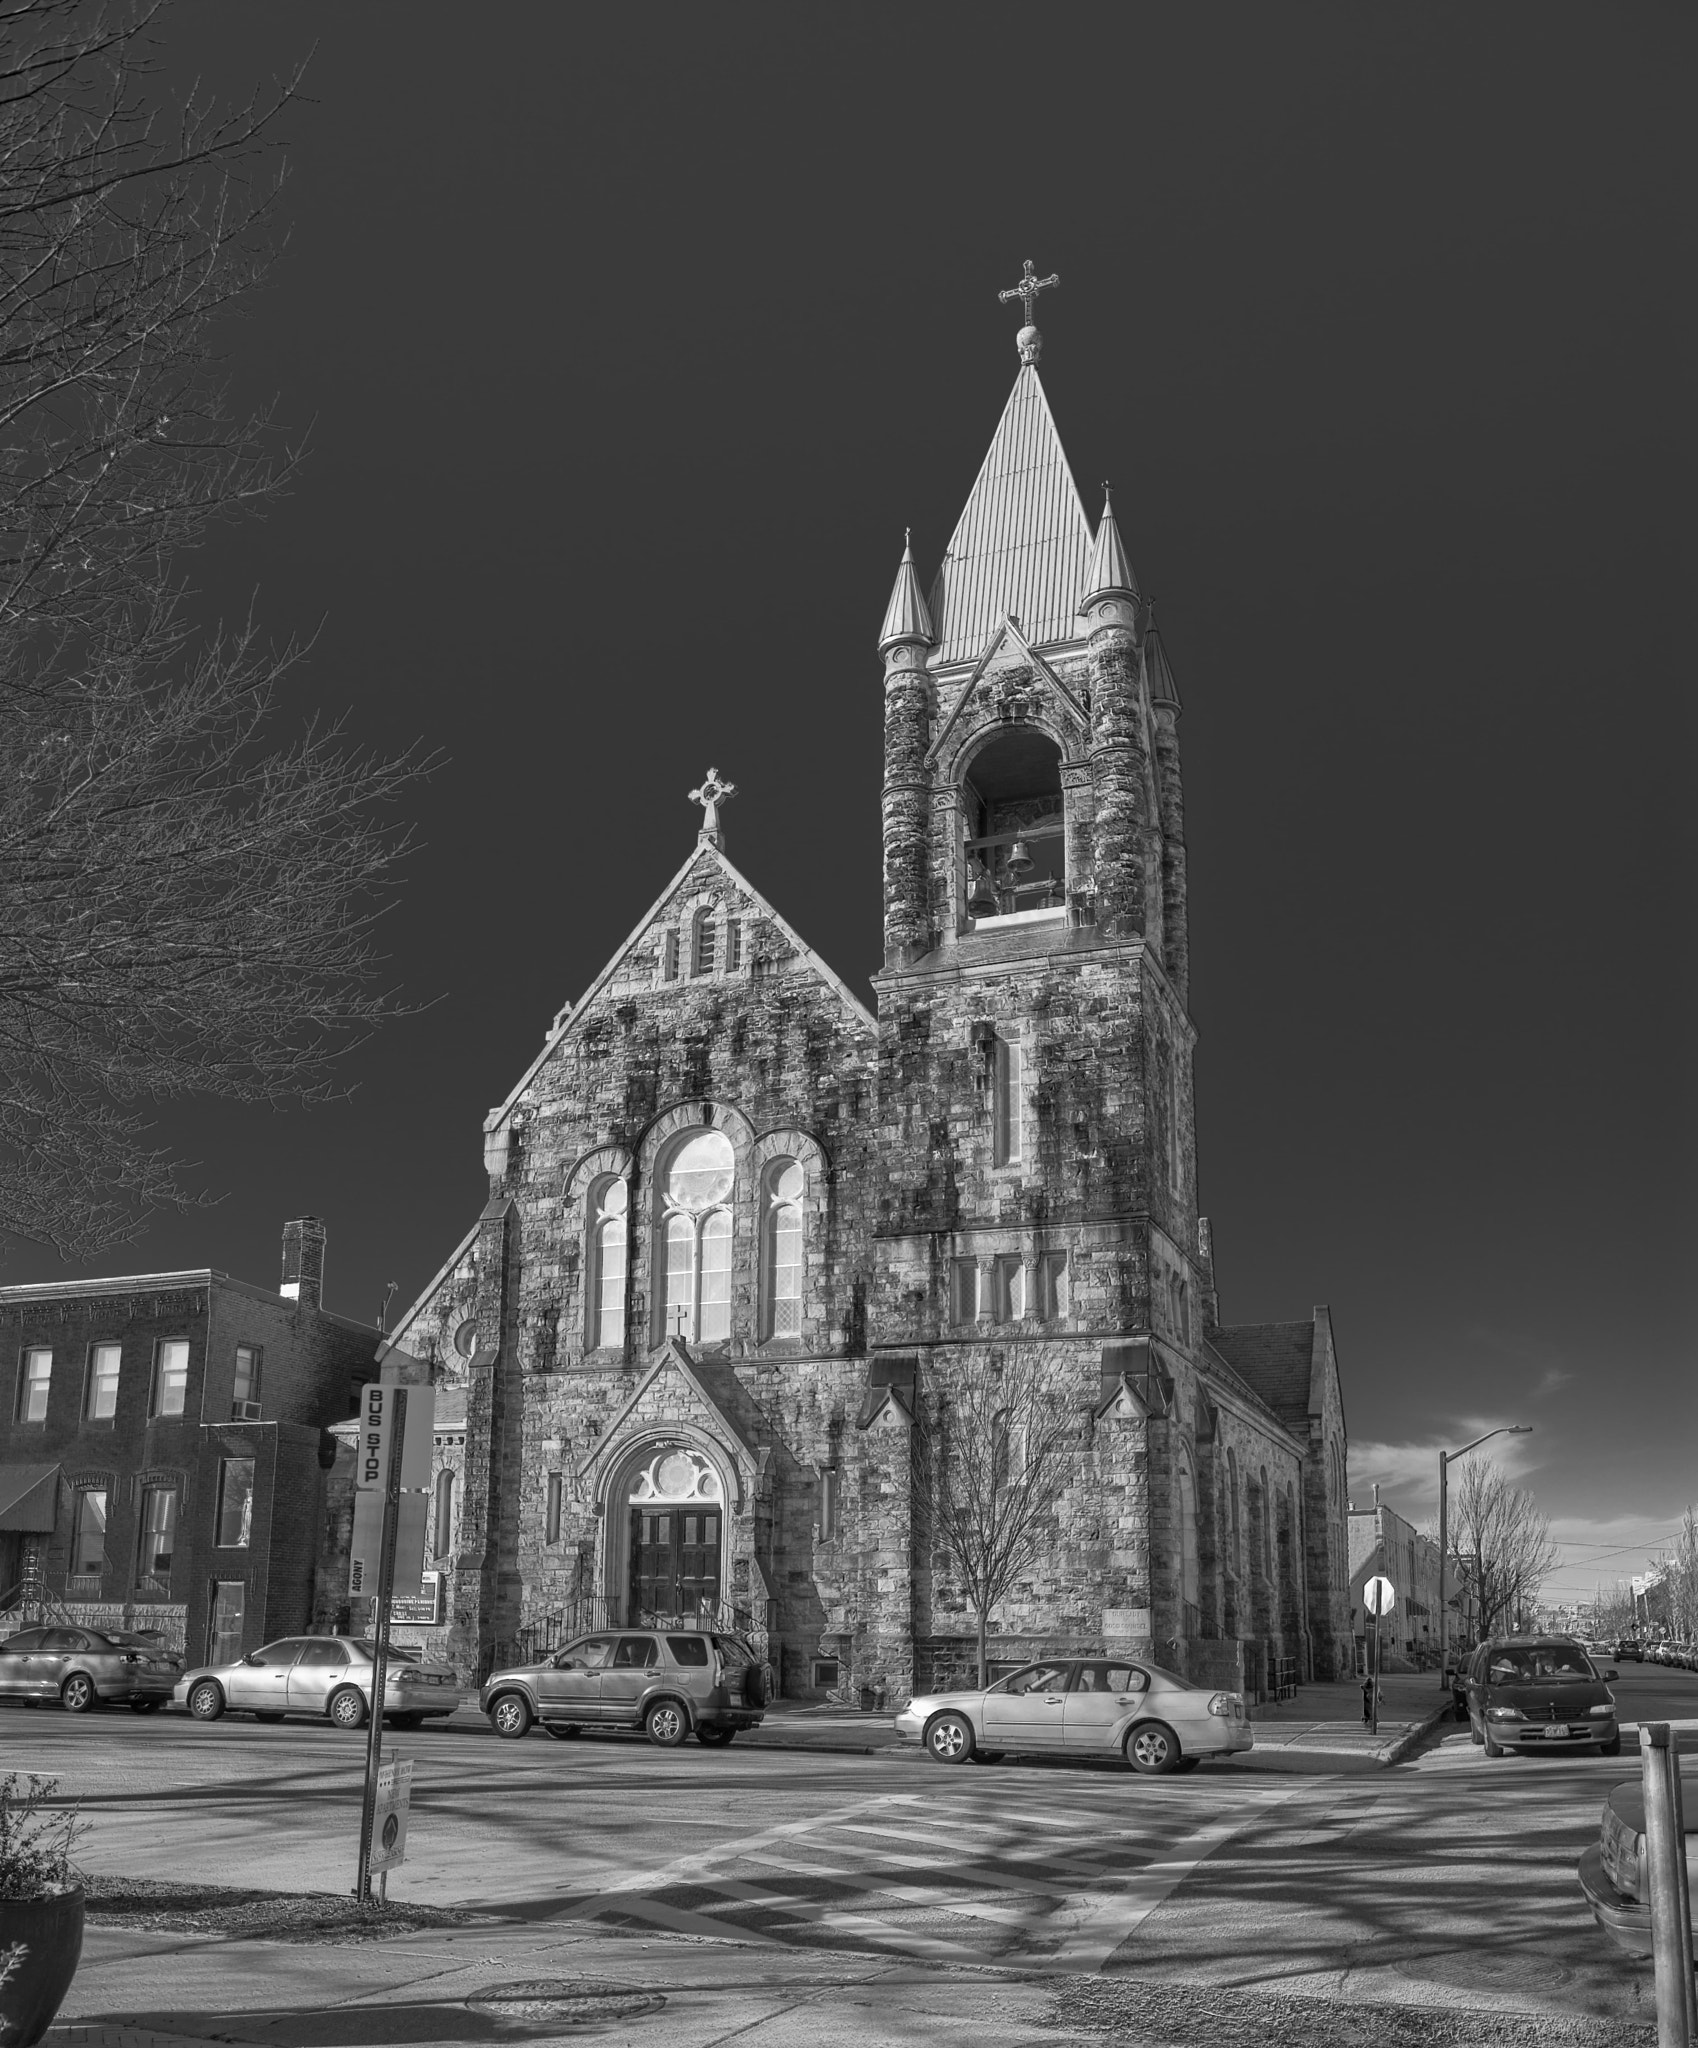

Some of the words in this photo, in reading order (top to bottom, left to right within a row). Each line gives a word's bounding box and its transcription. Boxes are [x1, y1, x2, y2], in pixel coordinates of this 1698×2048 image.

[368, 1390, 383, 1427] BUS
[365, 1433, 381, 1482] STOP
[351, 1559, 364, 1592] AGONY
